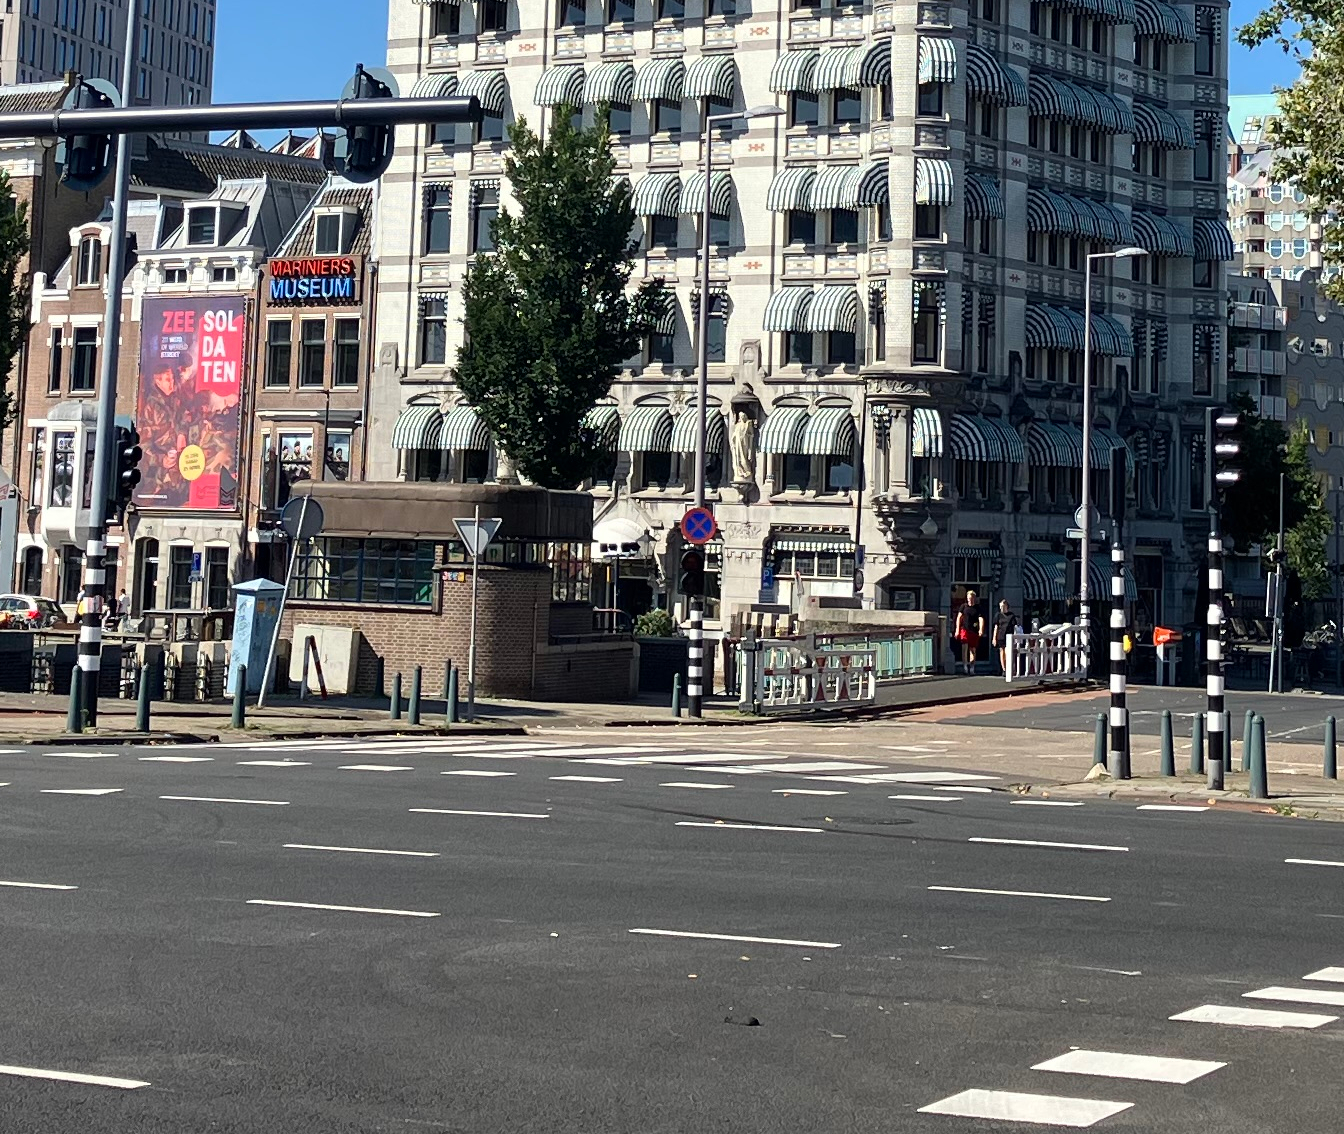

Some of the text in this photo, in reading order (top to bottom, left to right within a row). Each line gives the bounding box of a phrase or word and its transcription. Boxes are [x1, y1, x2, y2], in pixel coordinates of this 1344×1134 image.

[270, 257, 351, 277] MARINIERS
[269, 277, 351, 299] MUSEUM
[162, 309, 238, 333] ZEE SOL
[202, 335, 226, 358] DA
[201, 360, 236, 383] TEN
